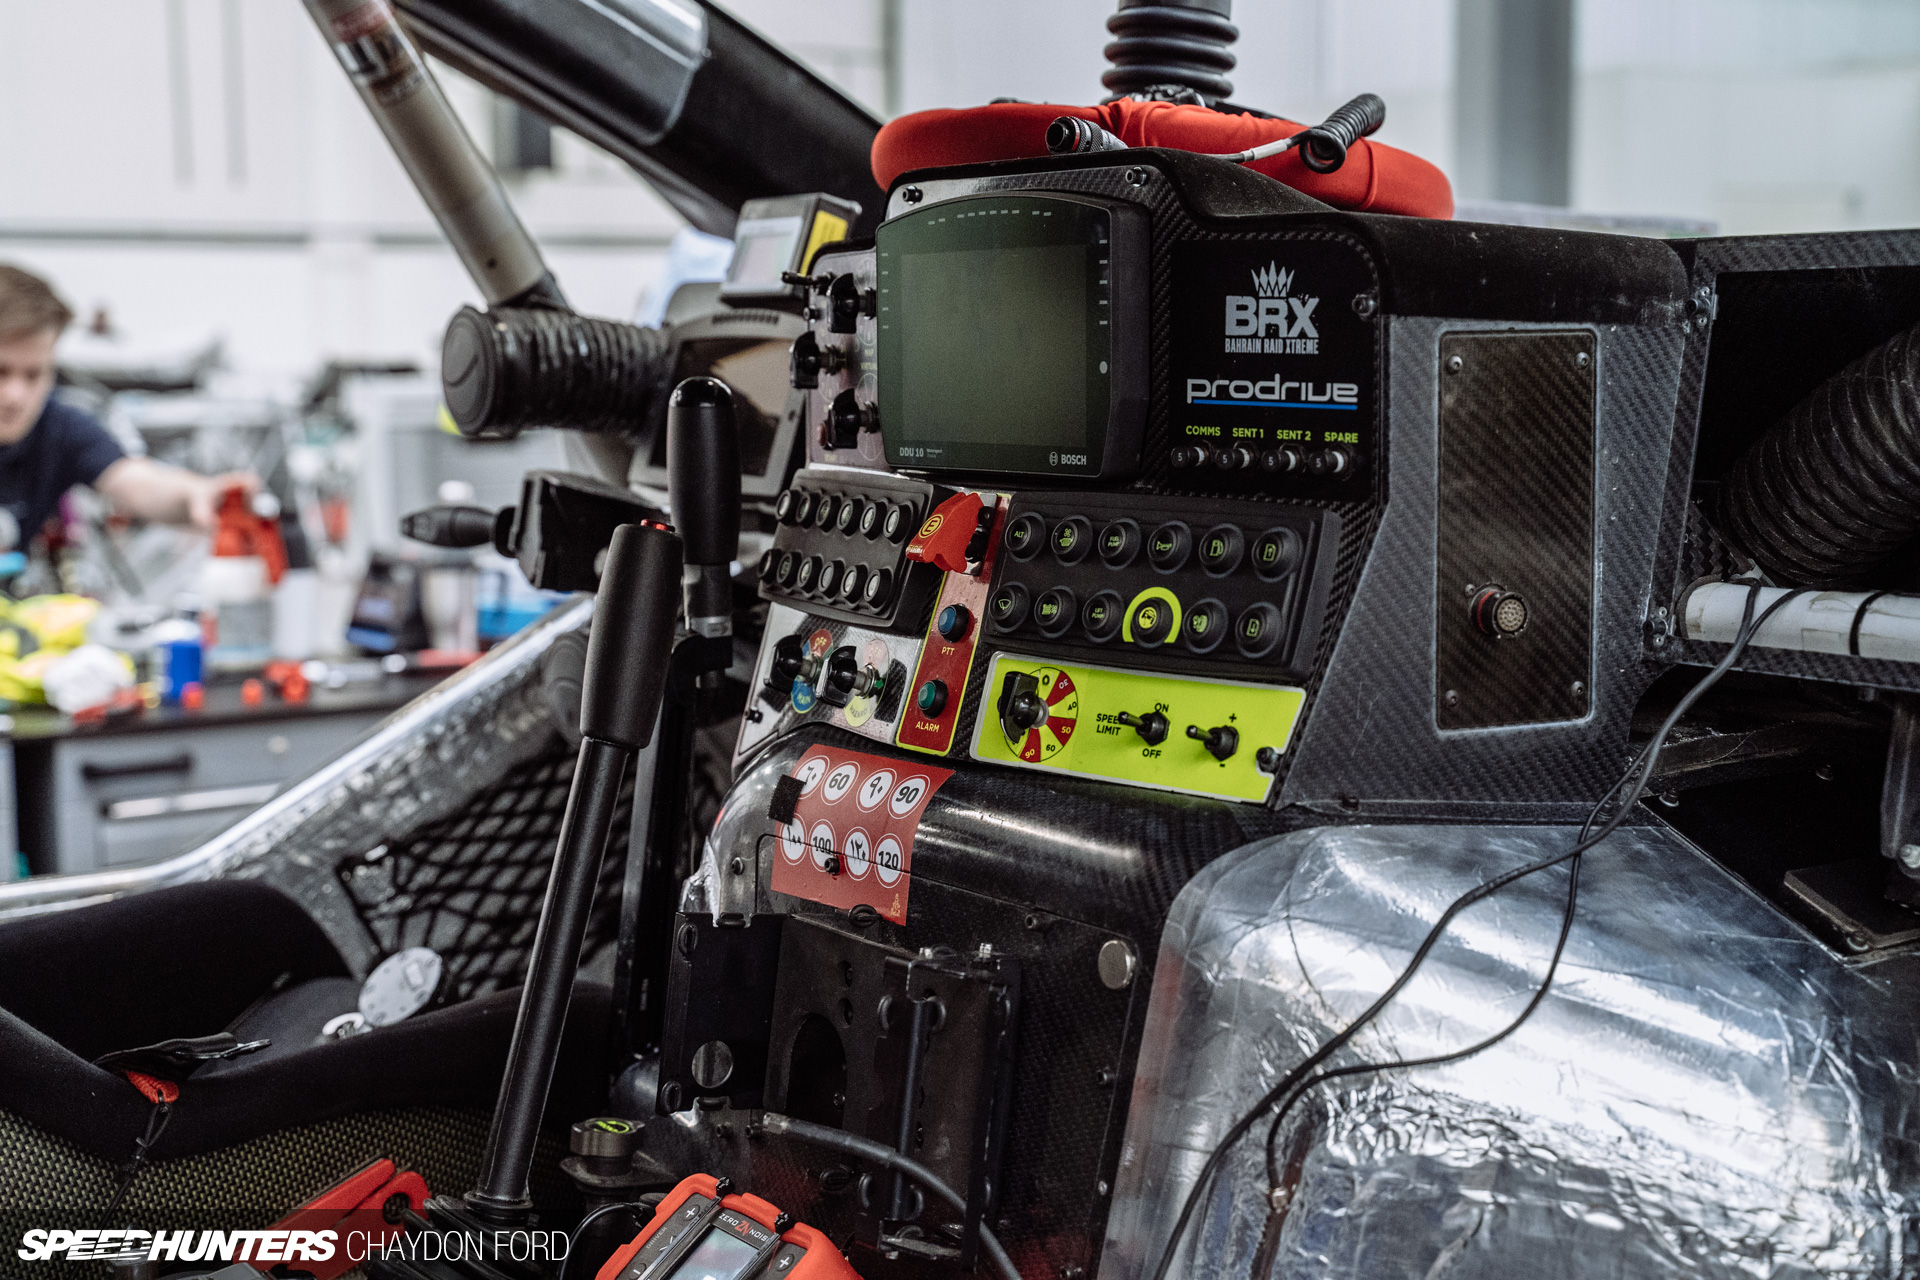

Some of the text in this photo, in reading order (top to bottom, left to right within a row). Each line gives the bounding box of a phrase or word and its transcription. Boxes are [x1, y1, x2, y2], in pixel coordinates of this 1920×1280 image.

[1225, 295, 1320, 338] BRX
[1225, 338, 1319, 355] BAHRAIN RAID XTREME
[1187, 373, 1359, 404] prodrive
[1185, 425, 1221, 437] COMMS
[1232, 427, 1264, 438] SENT 1
[1276, 429, 1312, 441] SENT 2
[1324, 432, 1359, 443] SPARE
[899, 447, 914, 457] DDU
[915, 447, 924, 458] 10
[1177, 453, 1183, 462] 5
[1061, 454, 1087, 466] BOSCH
[1222, 455, 1228, 464] 5
[1268, 457, 1274, 466] 5
[1315, 459, 1322, 468] 5
[1013, 530, 1025, 538] ALT
[941, 646, 955, 656] PTT
[1067, 701, 1078, 712] 40
[1154, 702, 1170, 713] ON
[1096, 713, 1120, 725] SPEE
[915, 720, 940, 733] ALARM
[1060, 725, 1072, 735] 50
[1096, 724, 1122, 736] LIMIT
[1024, 748, 1036, 759] 90
[1045, 744, 1056, 752] 60
[1142, 748, 1162, 760] OFF
[829, 773, 850, 790] 60
[895, 786, 920, 803] 90
[812, 835, 832, 854] 100
[878, 850, 900, 871] 120
[718, 1212, 739, 1227] ZERO
[645, 1226, 668, 1250] DRIVER
